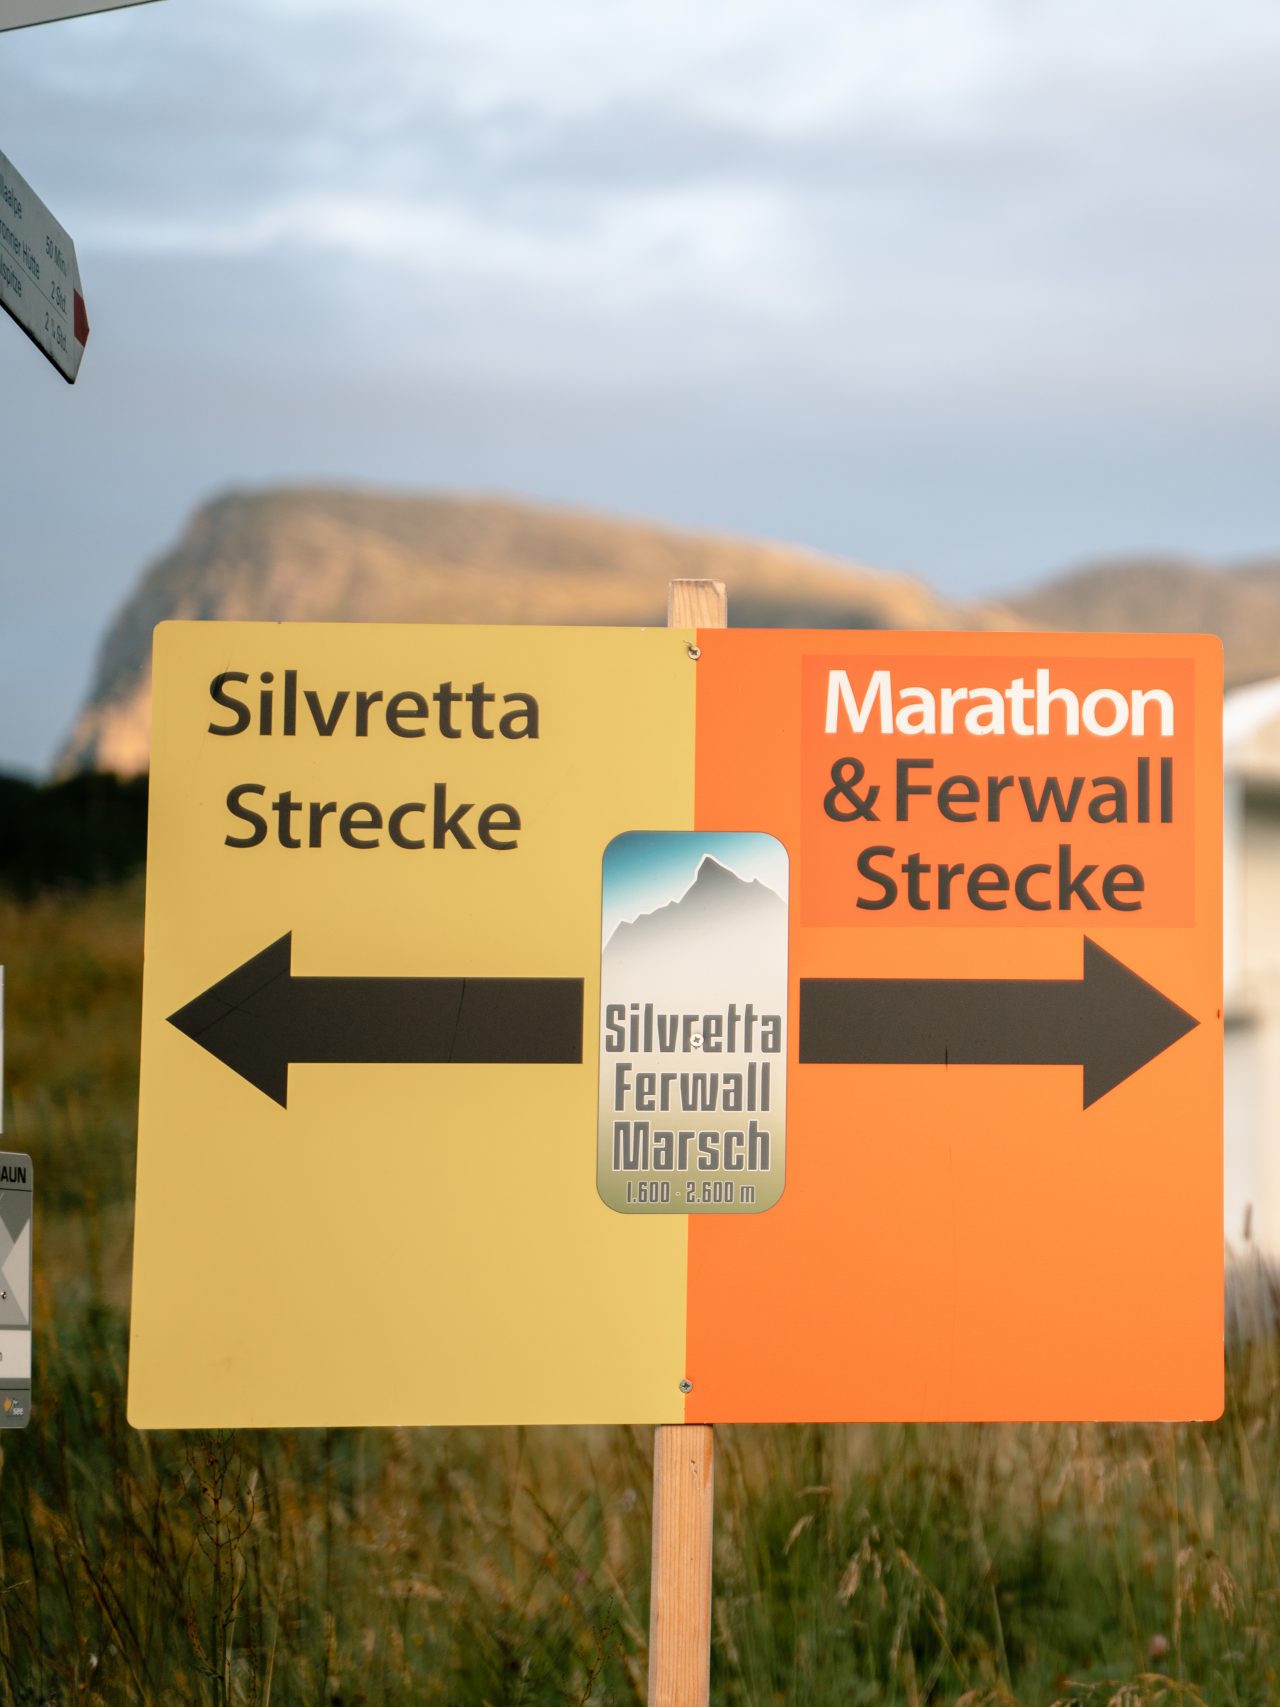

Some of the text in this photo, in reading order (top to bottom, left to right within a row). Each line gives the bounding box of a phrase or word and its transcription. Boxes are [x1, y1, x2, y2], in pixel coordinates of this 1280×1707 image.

[46, 236, 54, 258] 50
[22, 240, 40, 280] Hütte
[51, 281, 56, 299] 2
[56, 286, 67, 314] Std.
[45, 311, 50, 331] 2
[57, 325, 68, 353] Std.
[209, 671, 539, 740] Silvretta
[826, 669, 1174, 738] Marathon
[825, 759, 1173, 824] & Ferwall
[226, 784, 521, 851] Strecke
[858, 846, 1144, 912] Strecke
[605, 1003, 782, 1054] Silvretta
[614, 1062, 771, 1113] Ferwall
[612, 1120, 771, 1171] Marsch
[0, 1165, 26, 1184] AUN
[627, 1181, 671, 1203] 1.600
[686, 1181, 735, 1203] 2.600
[740, 1185, 755, 1203] m
